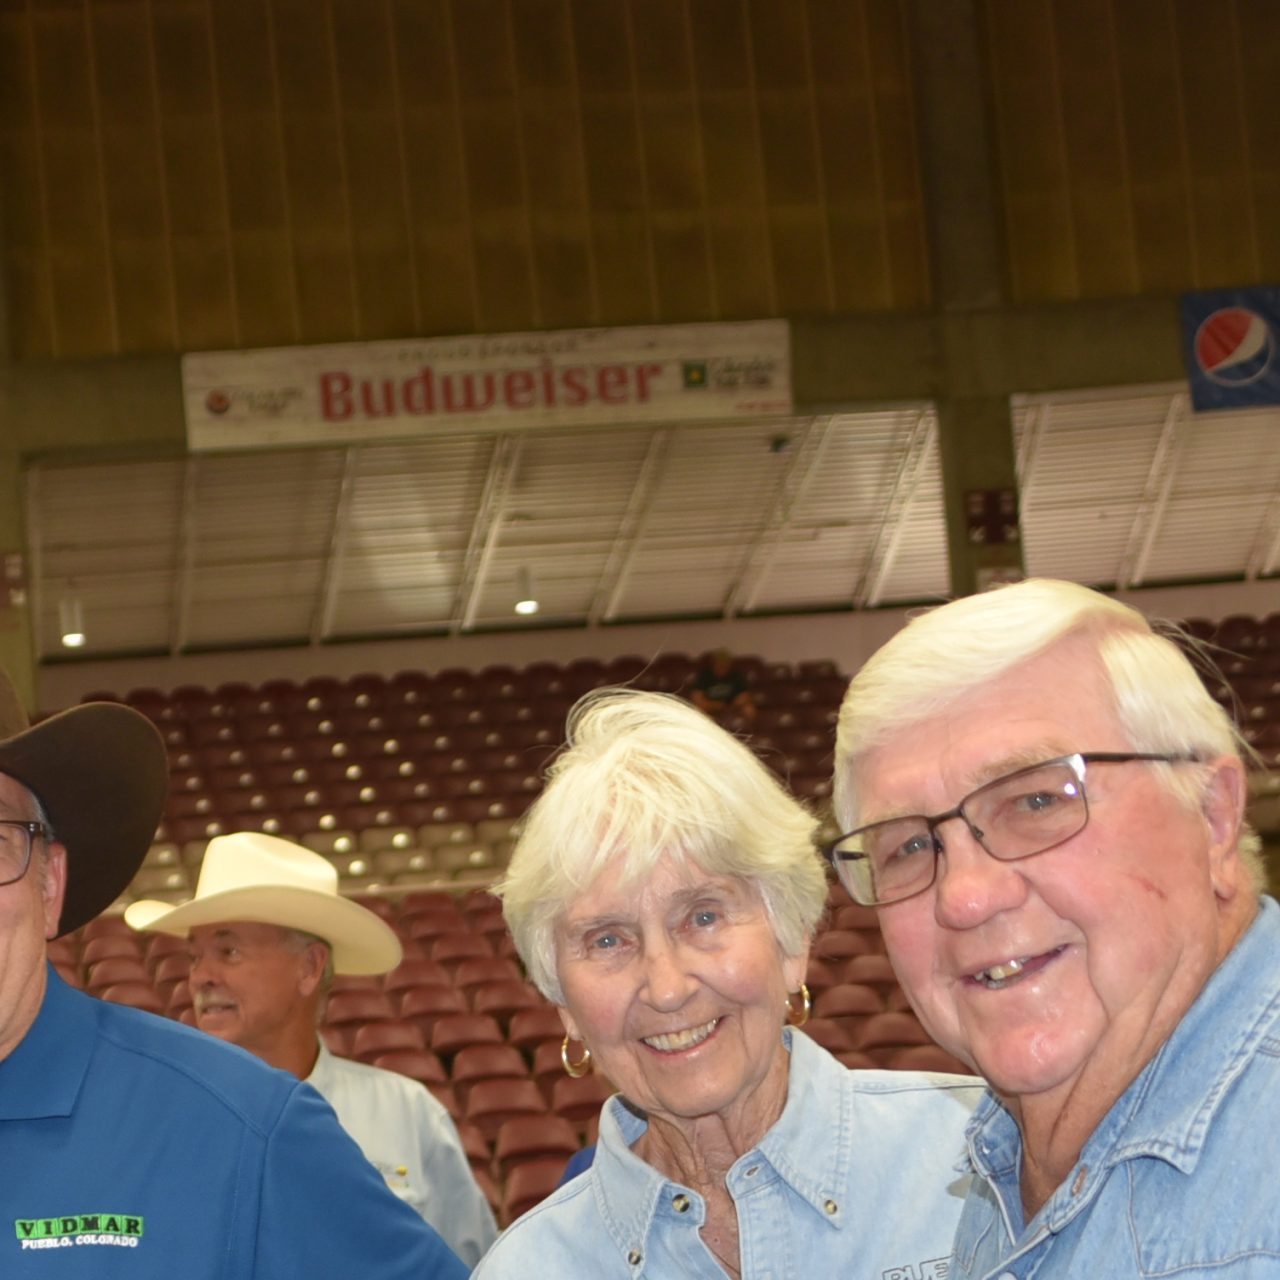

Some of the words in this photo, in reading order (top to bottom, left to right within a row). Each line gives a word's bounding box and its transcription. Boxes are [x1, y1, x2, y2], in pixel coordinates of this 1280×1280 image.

[320, 357, 664, 423] Budweiser
[18, 1215, 141, 1238] VIDMAR
[75, 1233, 138, 1248] COLORADO
